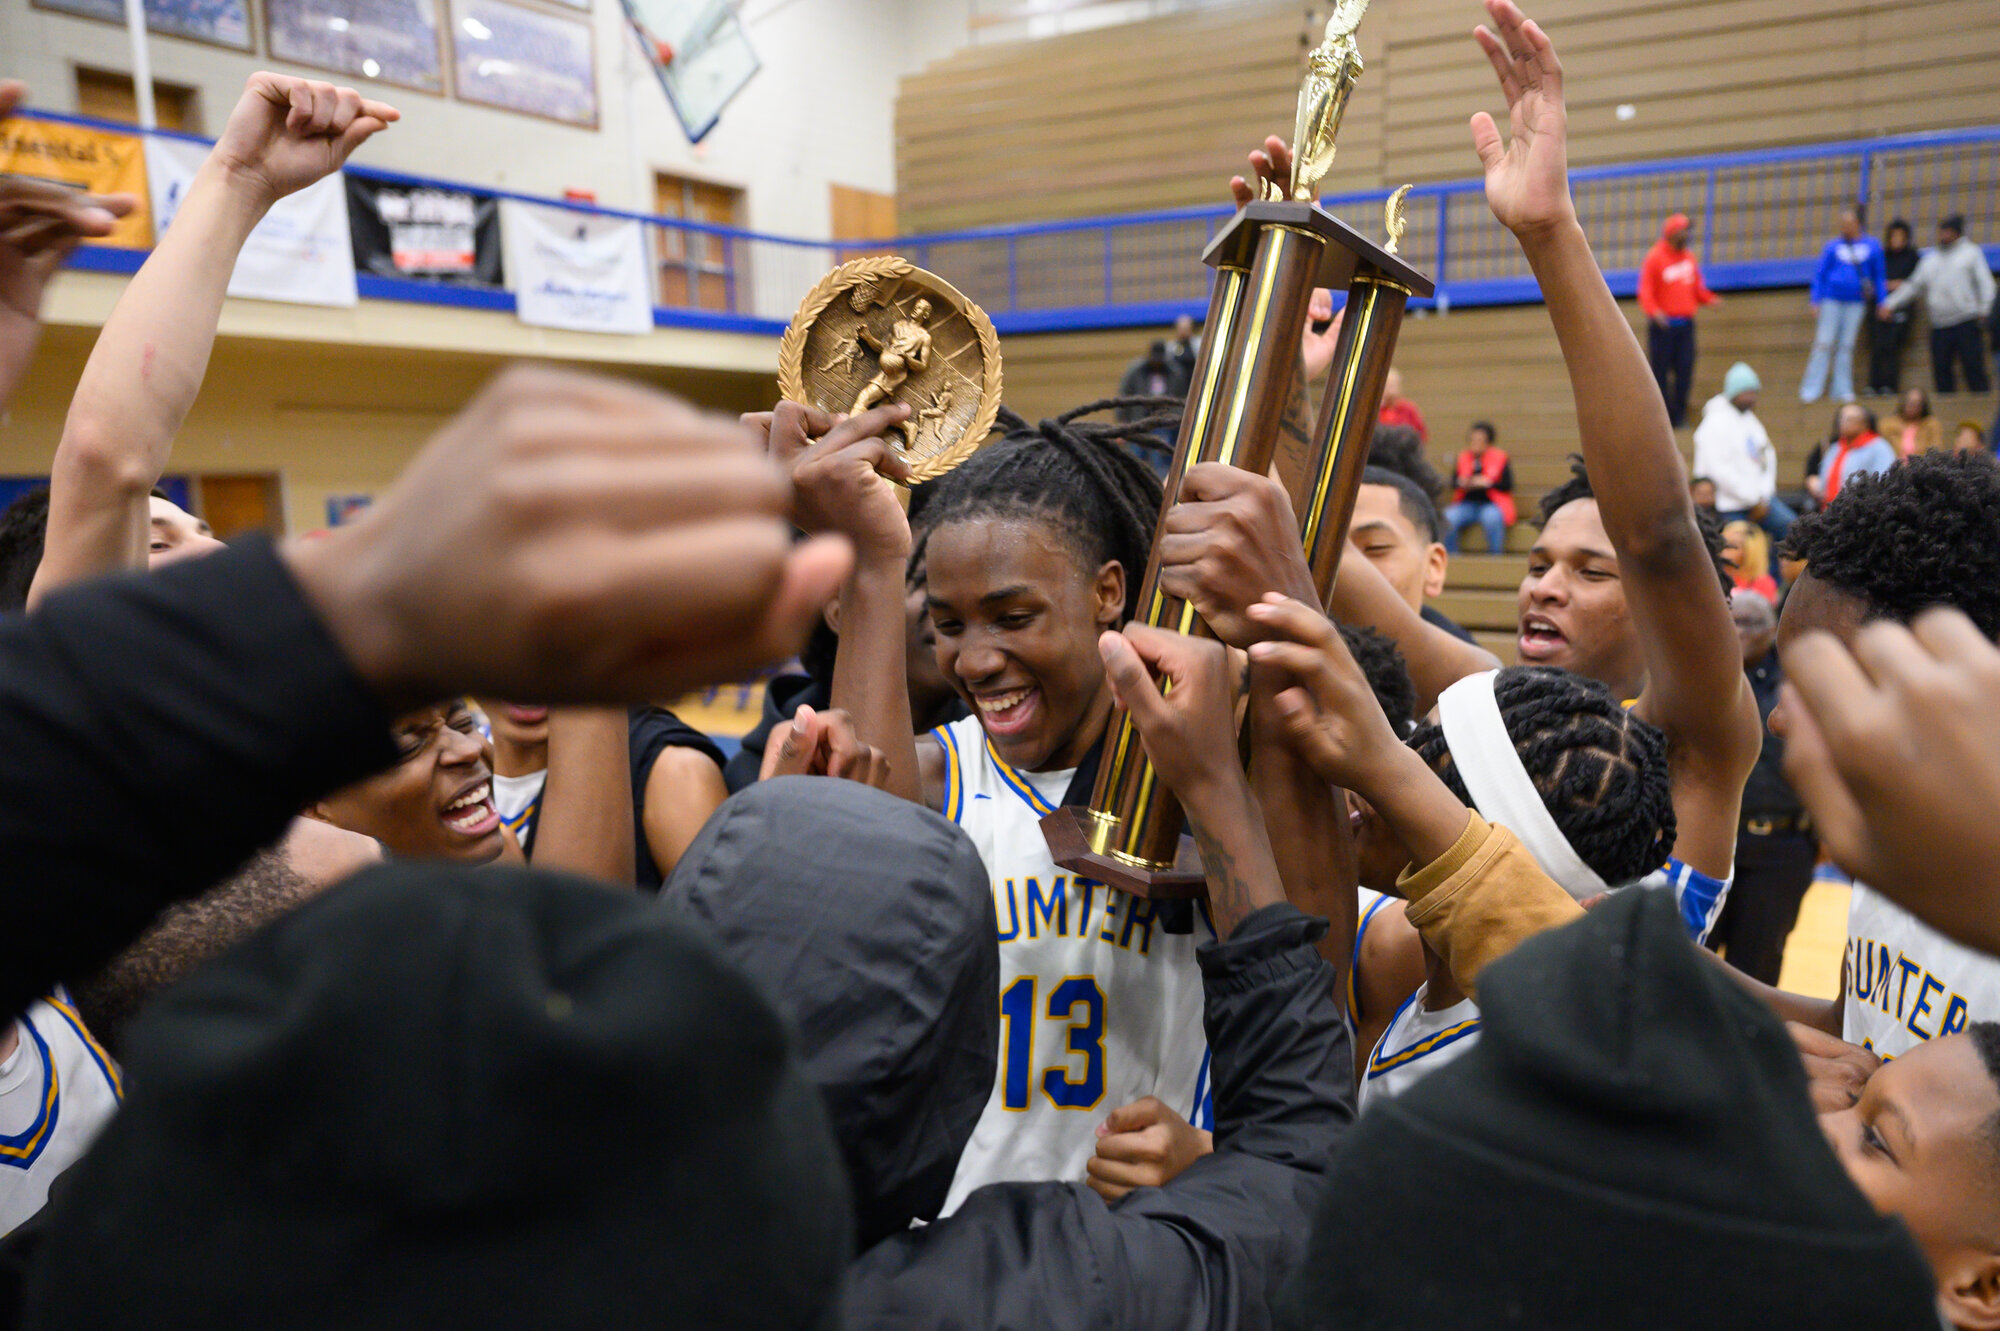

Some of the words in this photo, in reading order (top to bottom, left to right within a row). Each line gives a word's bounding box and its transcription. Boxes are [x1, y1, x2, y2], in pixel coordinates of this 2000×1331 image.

[991, 874, 1158, 956] UMTER
[1847, 936, 1969, 1042] SUMTER
[1000, 974, 1108, 1112] 13
